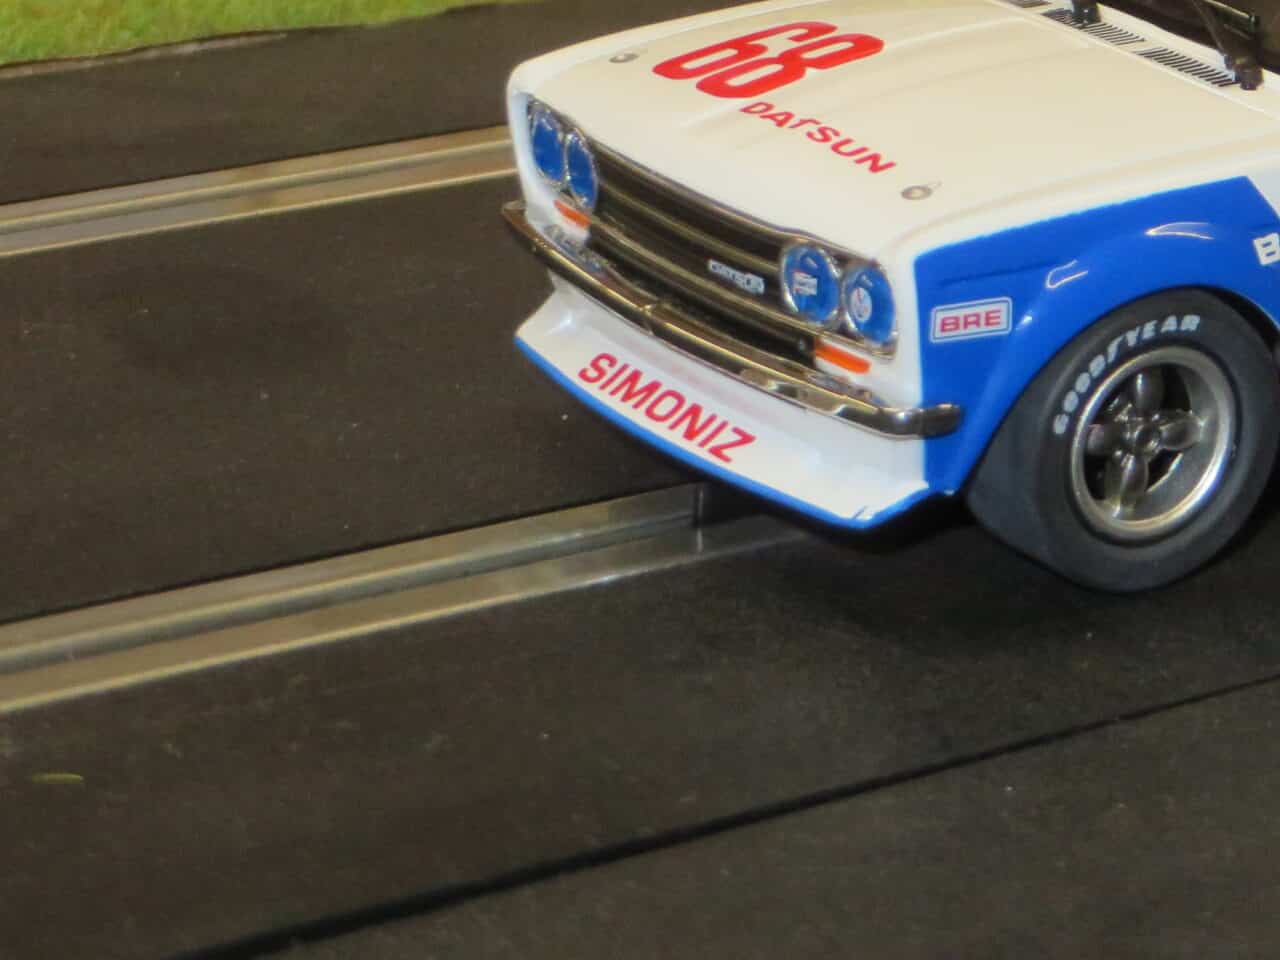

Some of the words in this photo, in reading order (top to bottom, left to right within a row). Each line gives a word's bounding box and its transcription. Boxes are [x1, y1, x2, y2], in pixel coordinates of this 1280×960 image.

[652, 20, 884, 99] 68
[739, 102, 896, 174] DATSUN
[938, 308, 1003, 334] BRE
[578, 352, 756, 464] SIMONIZ
